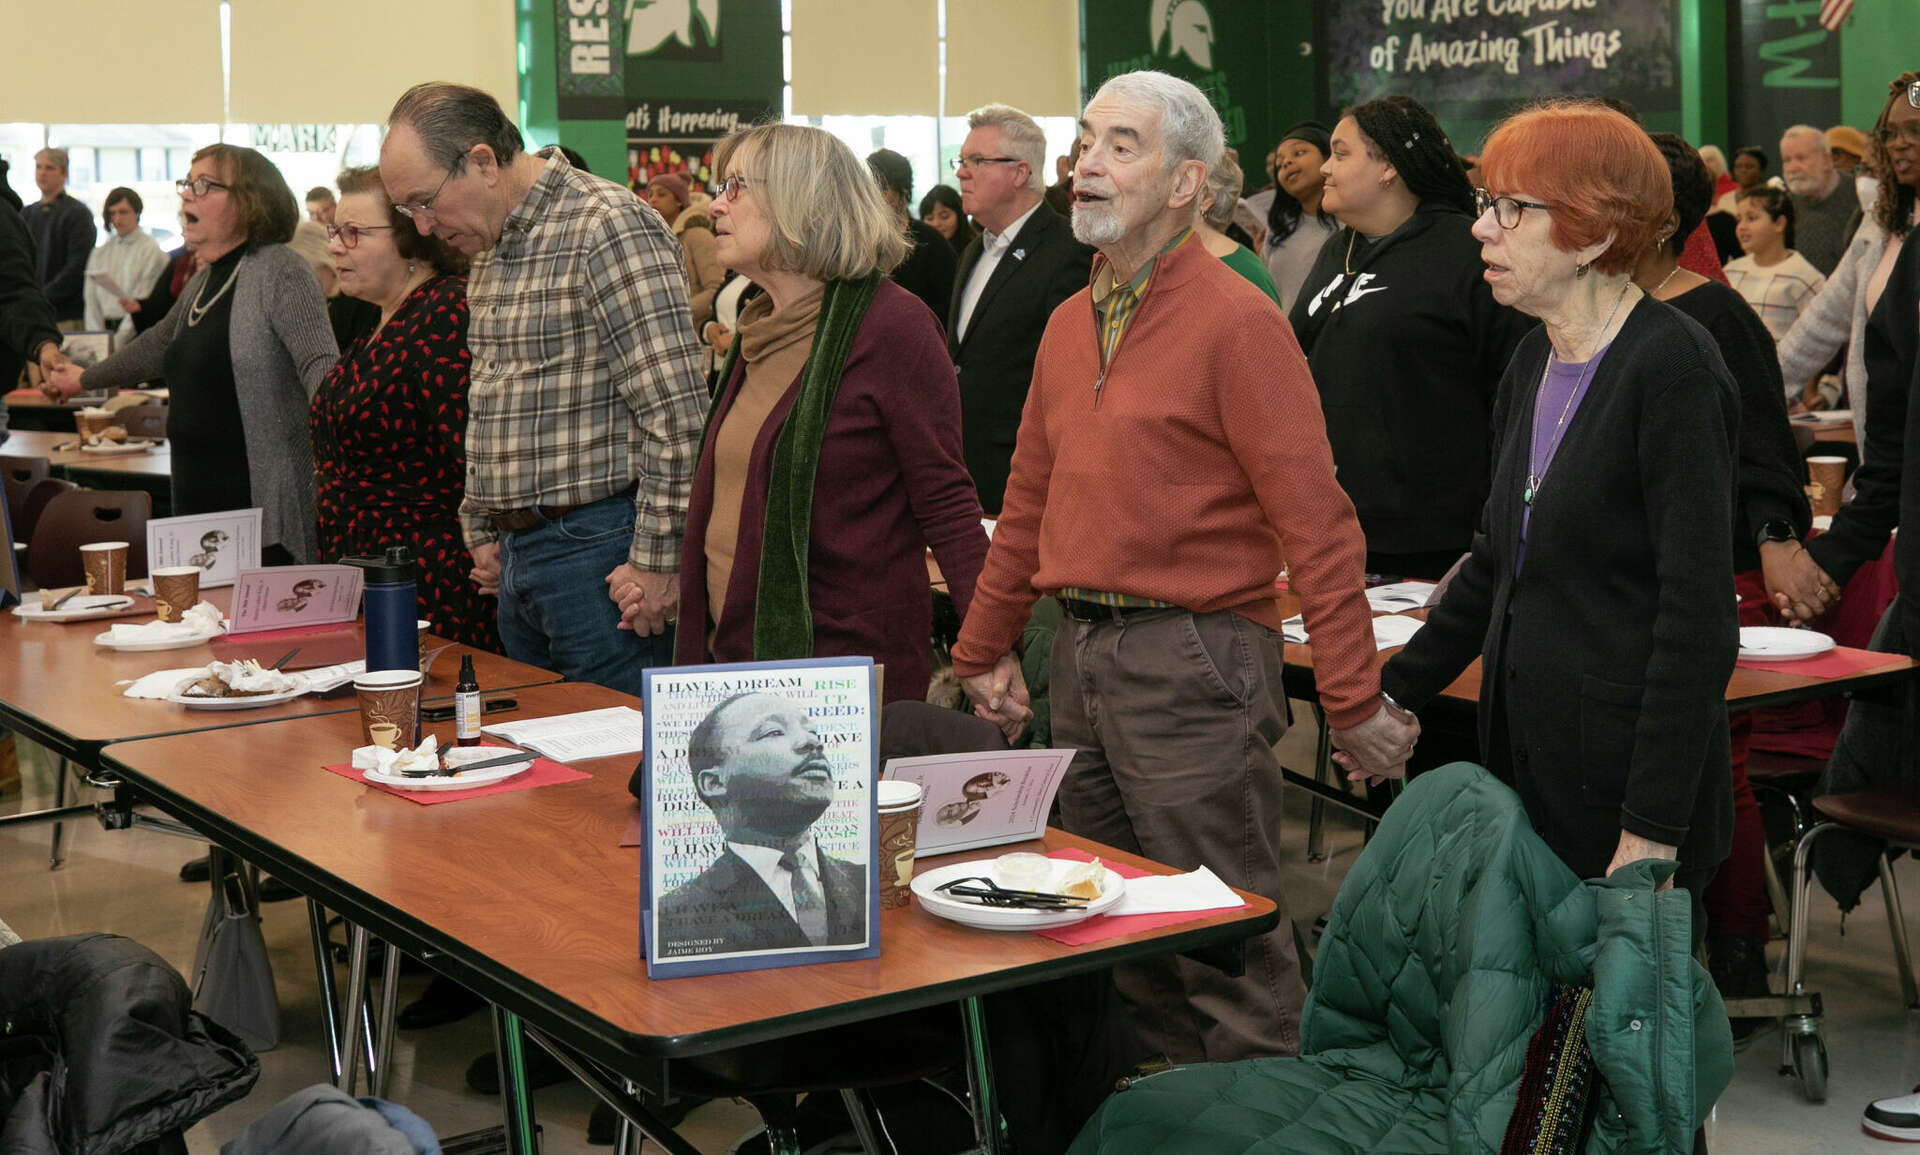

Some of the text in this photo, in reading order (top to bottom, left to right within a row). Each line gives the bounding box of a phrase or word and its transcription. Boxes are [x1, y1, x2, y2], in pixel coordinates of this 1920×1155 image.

[1370, 20, 1622, 74] of Amazing Things
[625, 103, 650, 130] at's
[656, 678, 802, 693] I HAVE A DREAM
[814, 679, 857, 690] RISE
[824, 694, 848, 704] UP
[807, 704, 865, 717] REED:
[812, 830, 859, 839] OASIS
[667, 936, 726, 948] DESIGNED BY
